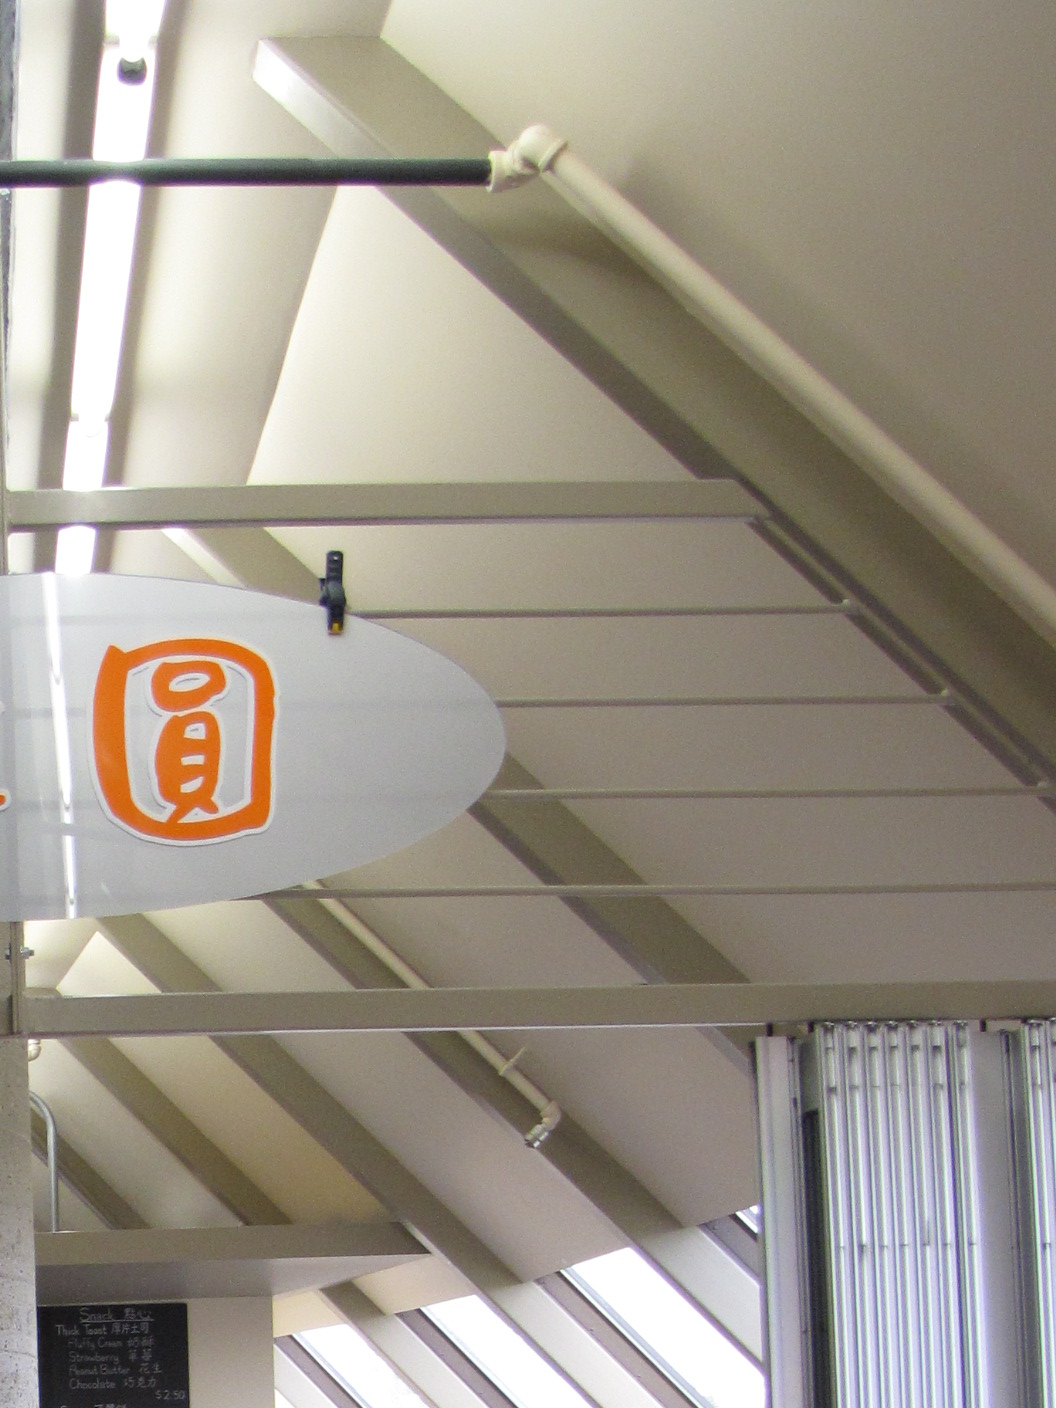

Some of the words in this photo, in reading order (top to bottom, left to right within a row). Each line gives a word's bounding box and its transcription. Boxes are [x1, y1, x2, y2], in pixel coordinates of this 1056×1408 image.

[80, 1307, 113, 1321] Snack
[56, 1324, 81, 1336] Thick
[84, 1324, 108, 1335] Toast
[97, 1336, 123, 1348] Cream
[69, 1350, 119, 1364] Strawberry
[69, 1364, 99, 1376] Peanut
[100, 1363, 130, 1376] Butter
[69, 1377, 116, 1390] Chocolate
